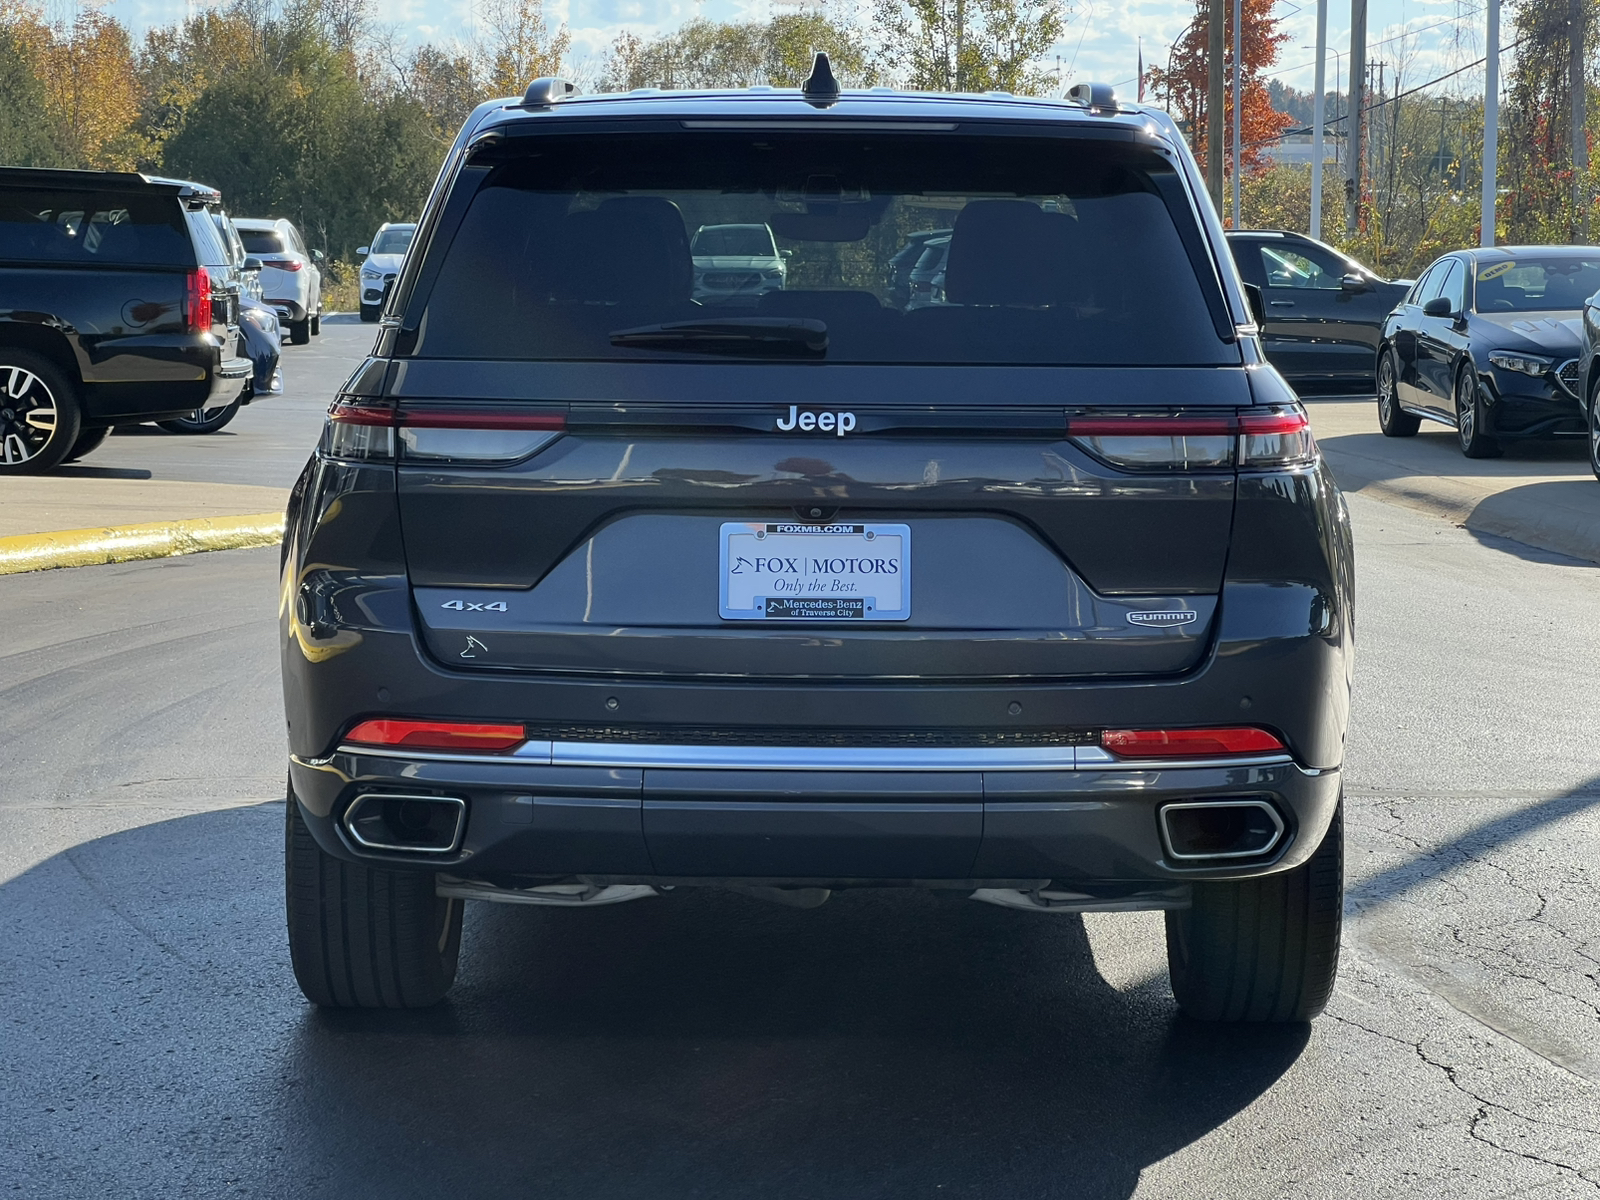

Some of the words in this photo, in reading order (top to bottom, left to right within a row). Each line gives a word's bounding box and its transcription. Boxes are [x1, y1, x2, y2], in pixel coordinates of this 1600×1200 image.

[1484, 264, 1508, 278] DEMO
[776, 405, 857, 436] Jeep
[777, 525, 854, 533] FOXMB.COM
[755, 557, 798, 573] FOX
[812, 558, 898, 574] MOTORS
[774, 578, 804, 595] Only
[808, 578, 826, 592] the
[831, 579, 858, 592] Best.
[441, 600, 508, 612] 4x4
[783, 600, 862, 609] Mercedes-Benz
[838, 609, 854, 618] City
[1131, 613, 1194, 621] SUMMIT
